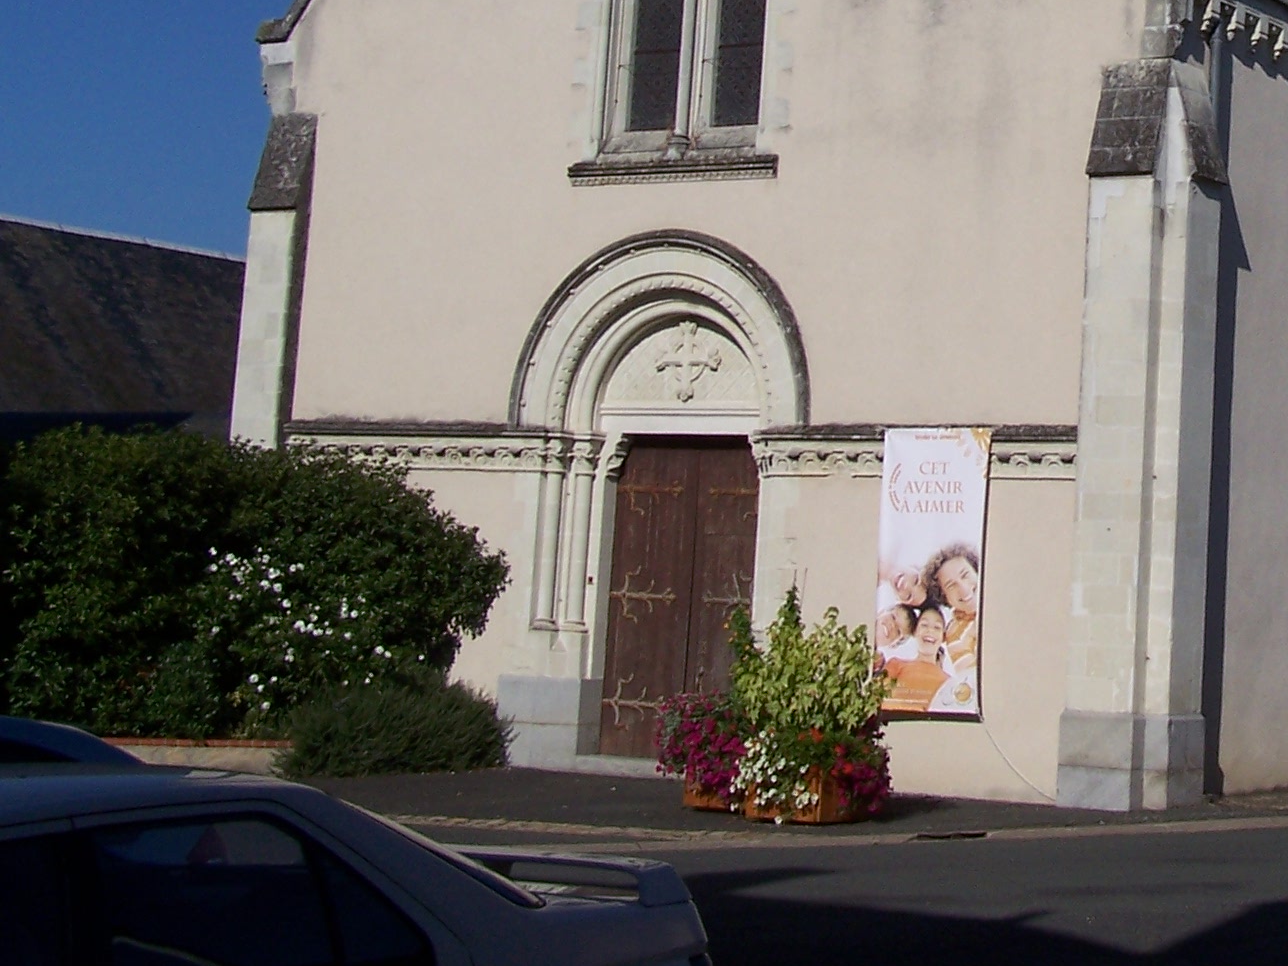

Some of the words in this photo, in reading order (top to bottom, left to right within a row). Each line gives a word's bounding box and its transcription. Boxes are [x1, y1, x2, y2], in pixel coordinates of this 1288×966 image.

[919, 461, 950, 475] CET
[904, 480, 963, 495] AVENIR
[913, 500, 965, 513] AIMER
